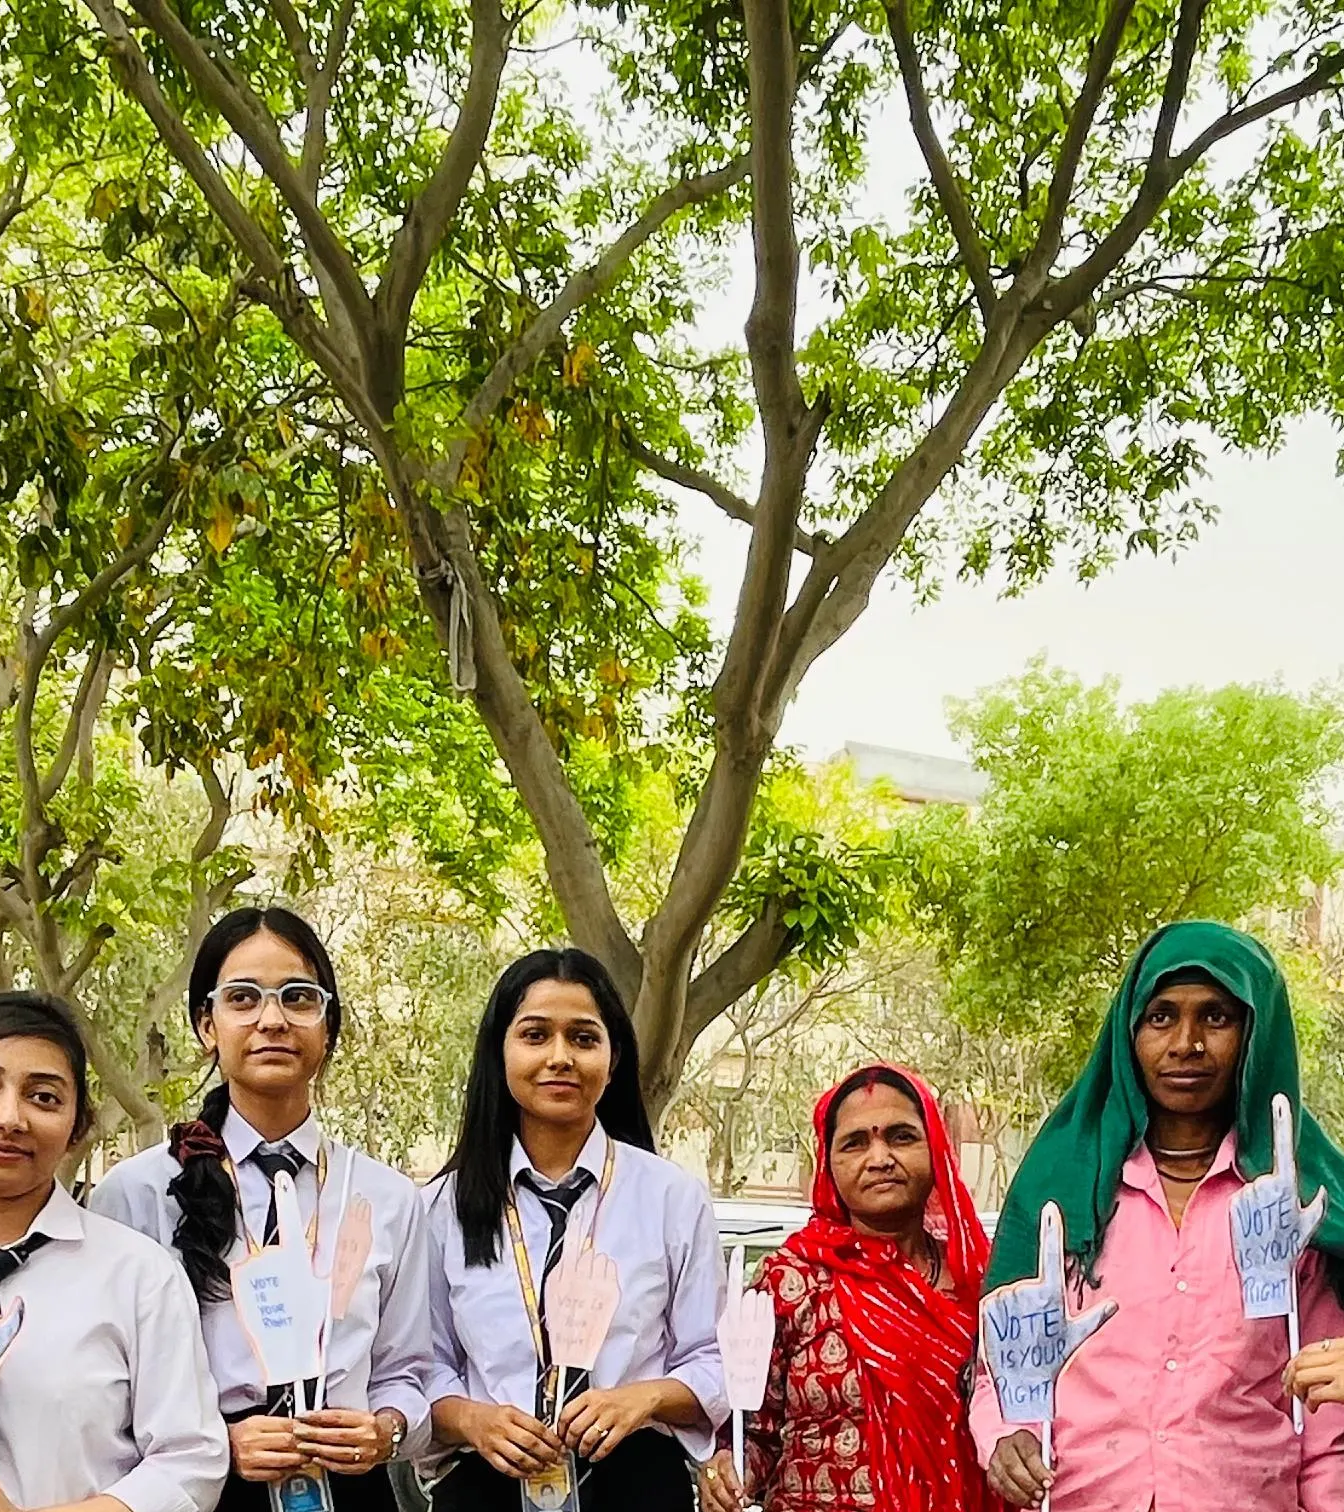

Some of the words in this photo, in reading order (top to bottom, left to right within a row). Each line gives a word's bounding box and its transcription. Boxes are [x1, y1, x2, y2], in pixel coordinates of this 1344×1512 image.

[1237, 1194, 1293, 1239] VOTE
[1239, 1248, 1253, 1270] IS
[1259, 1229, 1301, 1264] YOUR
[1242, 1277, 1288, 1304] RIGHT
[989, 1307, 1060, 1342] VOTE
[1020, 1338, 1066, 1368] YOUR
[994, 1376, 1052, 1406] RIGHT
